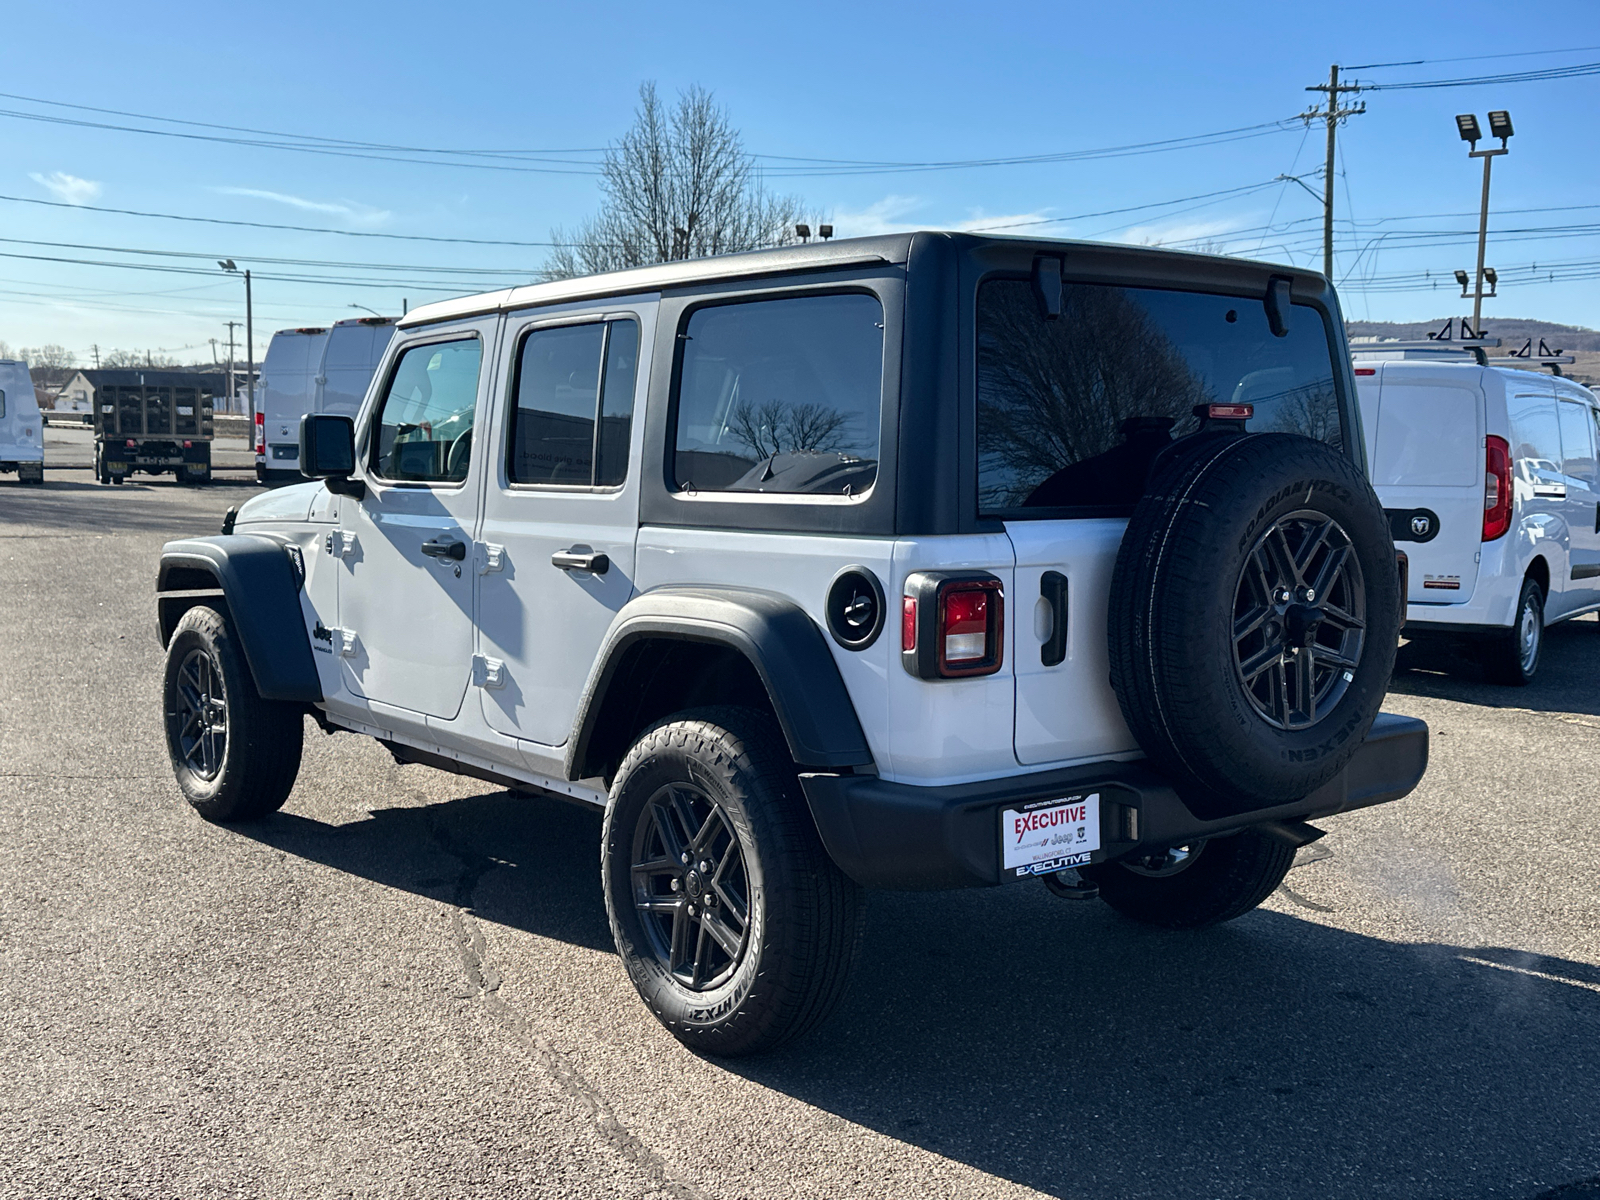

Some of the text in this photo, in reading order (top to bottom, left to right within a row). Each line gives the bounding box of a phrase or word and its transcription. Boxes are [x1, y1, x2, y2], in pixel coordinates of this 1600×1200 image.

[1238, 480, 1304, 554] ROADIAN
[1288, 711, 1361, 763] NEXEN
[1014, 806, 1086, 844] EXECUTIVE
[1050, 833, 1074, 846] Jeep
[1016, 852, 1092, 877] EXECUTIVE
[735, 901, 762, 1002] ROADIAN
